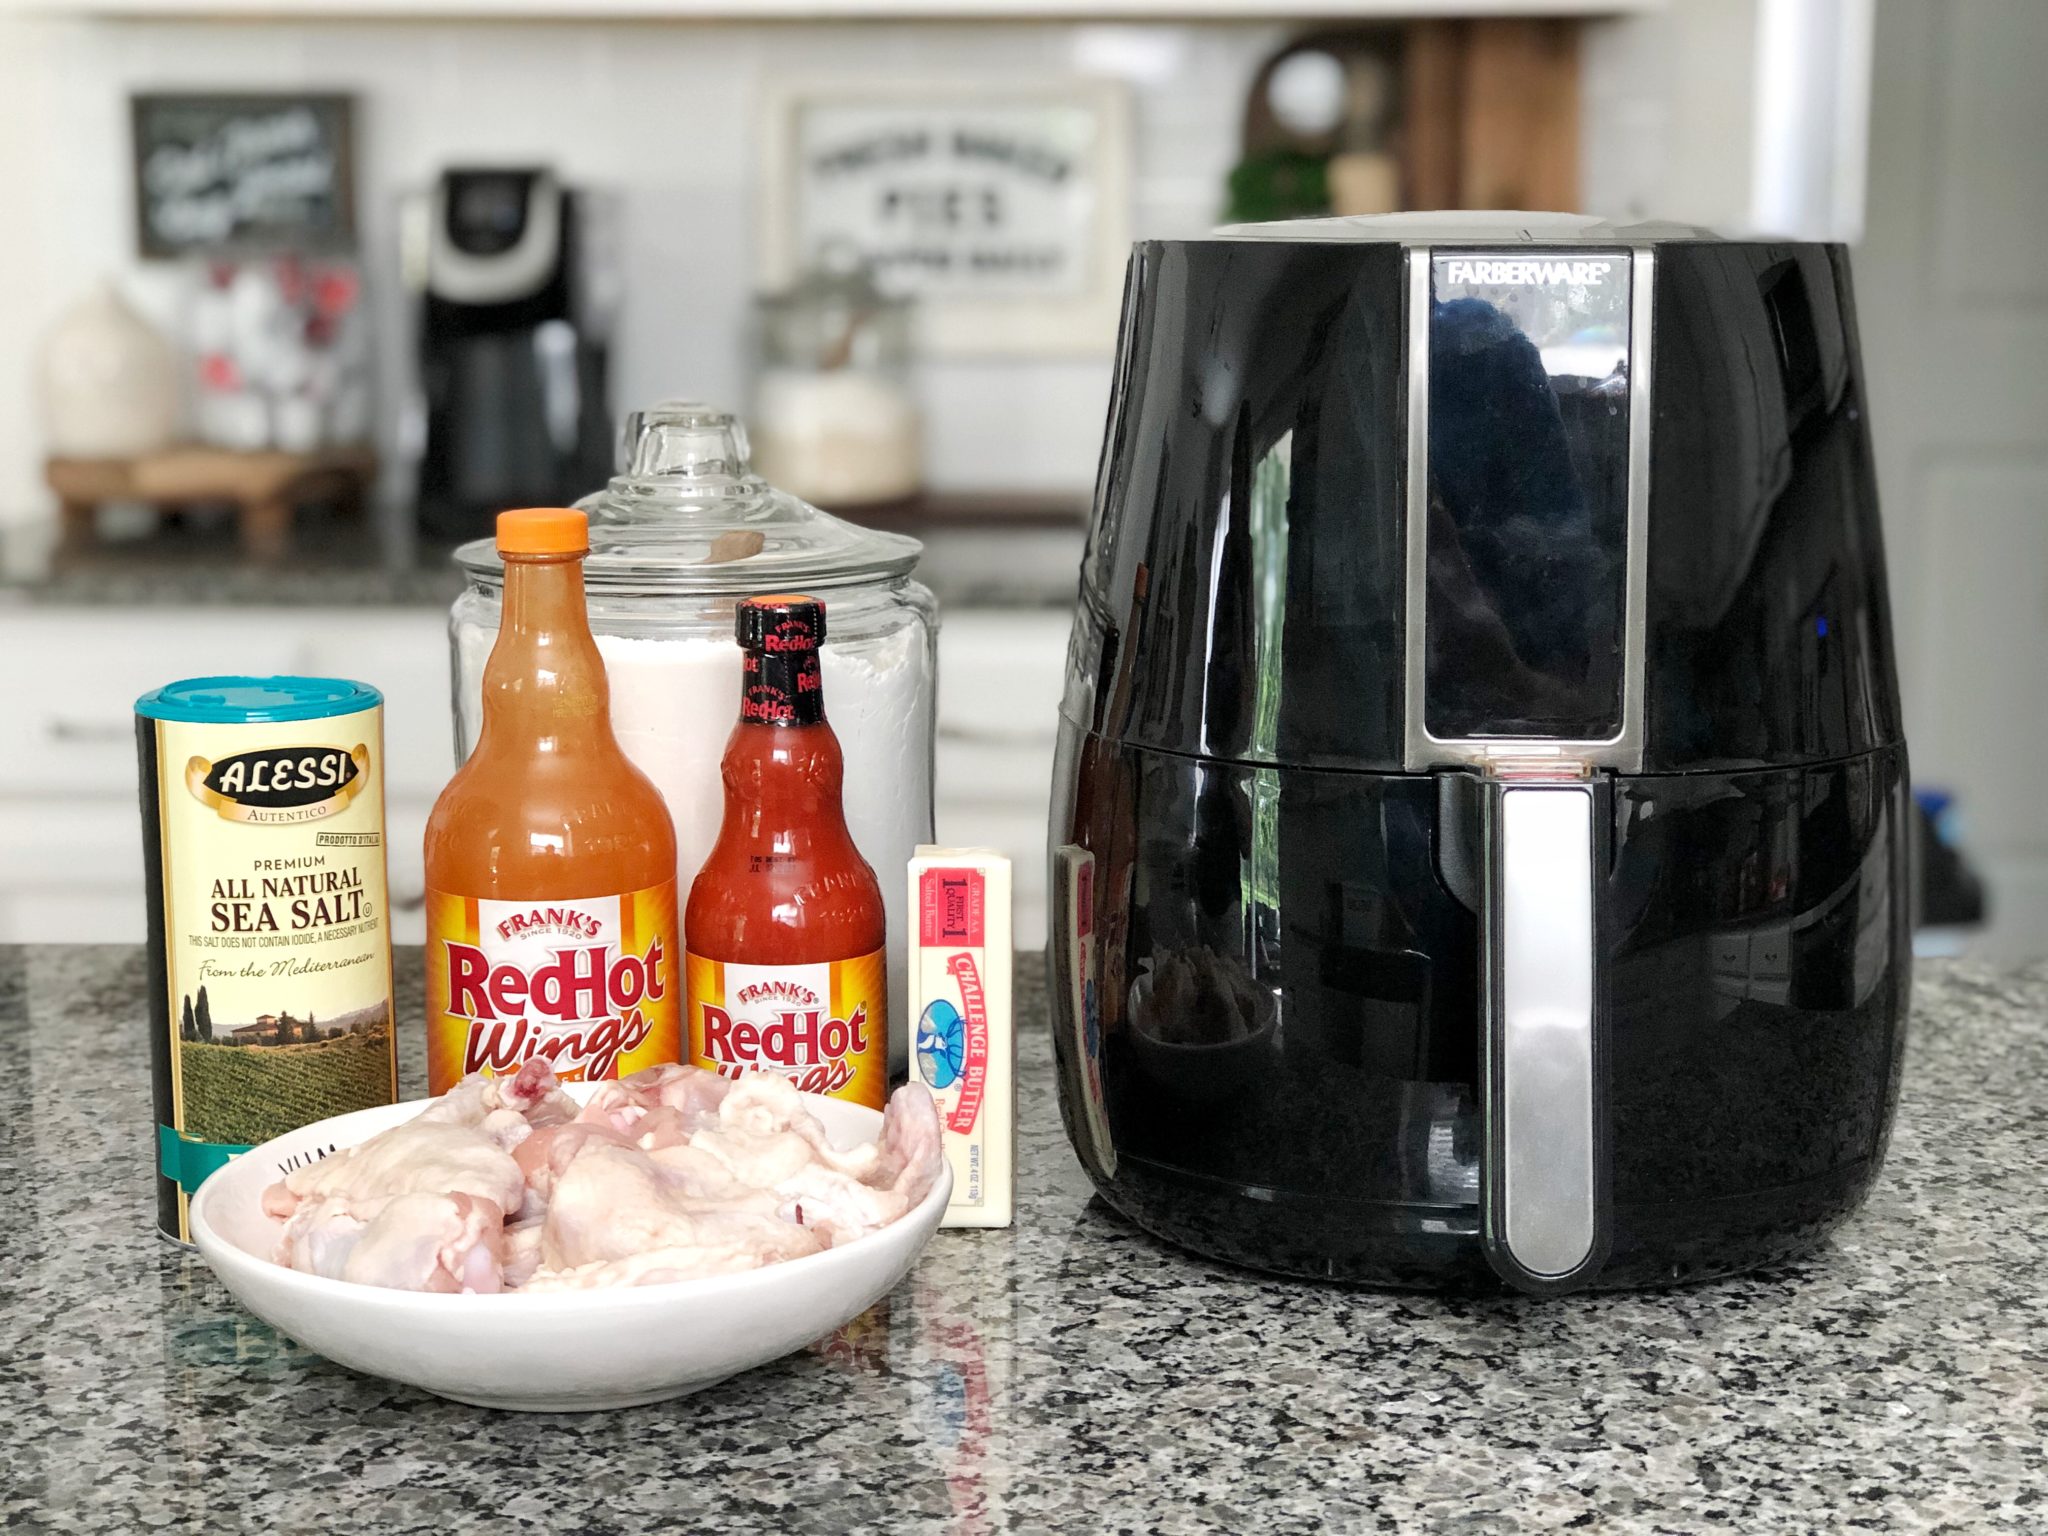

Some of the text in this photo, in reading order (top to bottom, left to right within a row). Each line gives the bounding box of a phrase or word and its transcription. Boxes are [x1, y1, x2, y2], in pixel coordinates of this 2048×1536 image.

[1448, 262, 1603, 285] FARBERWARE
[742, 696, 795, 720] RedHot
[219, 753, 347, 793] ALESSI
[247, 805, 327, 822] AUTENTICO
[319, 835, 357, 845] PRODOTTO
[254, 855, 326, 871] PREMIUM
[211, 867, 362, 899] ALL NATURAL
[211, 889, 364, 932] SEA SALT
[946, 888, 955, 928] QUALITY
[956, 895, 964, 921] FIRST
[188, 935, 202, 946] THIS
[204, 936, 219, 947] SALT
[221, 937, 240, 948] DOES
[242, 937, 257, 948] NOT
[259, 935, 289, 947] CONTAIN
[317, 932, 323, 942] A
[324, 925, 357, 941] NECESSARY
[496, 908, 603, 941] FRANK'S
[520, 928, 583, 940] SINCE 1920
[199, 952, 376, 981] From the Mediterranean
[442, 934, 667, 1021] RedHot
[737, 981, 816, 1005] FRANK'S
[463, 1008, 653, 1081] Wings
[699, 1001, 869, 1068] RedHot
[954, 957, 986, 1129] CHALLENGE BUTTER
[970, 1145, 979, 1156] NET
